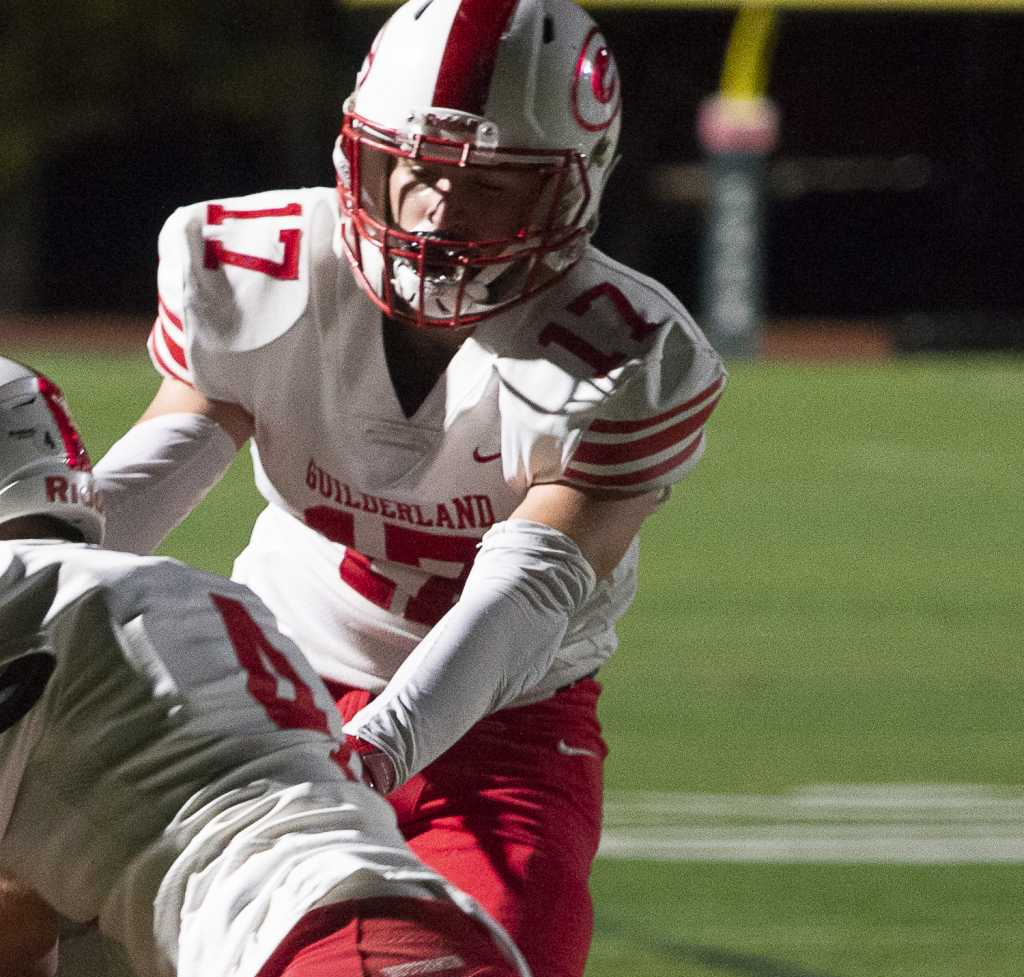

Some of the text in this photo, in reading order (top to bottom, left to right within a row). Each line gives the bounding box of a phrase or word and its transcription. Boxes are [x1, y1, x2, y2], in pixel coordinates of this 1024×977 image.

[203, 203, 302, 281] 17
[537, 281, 660, 379] 17
[305, 458, 497, 529] GUILDERLAND
